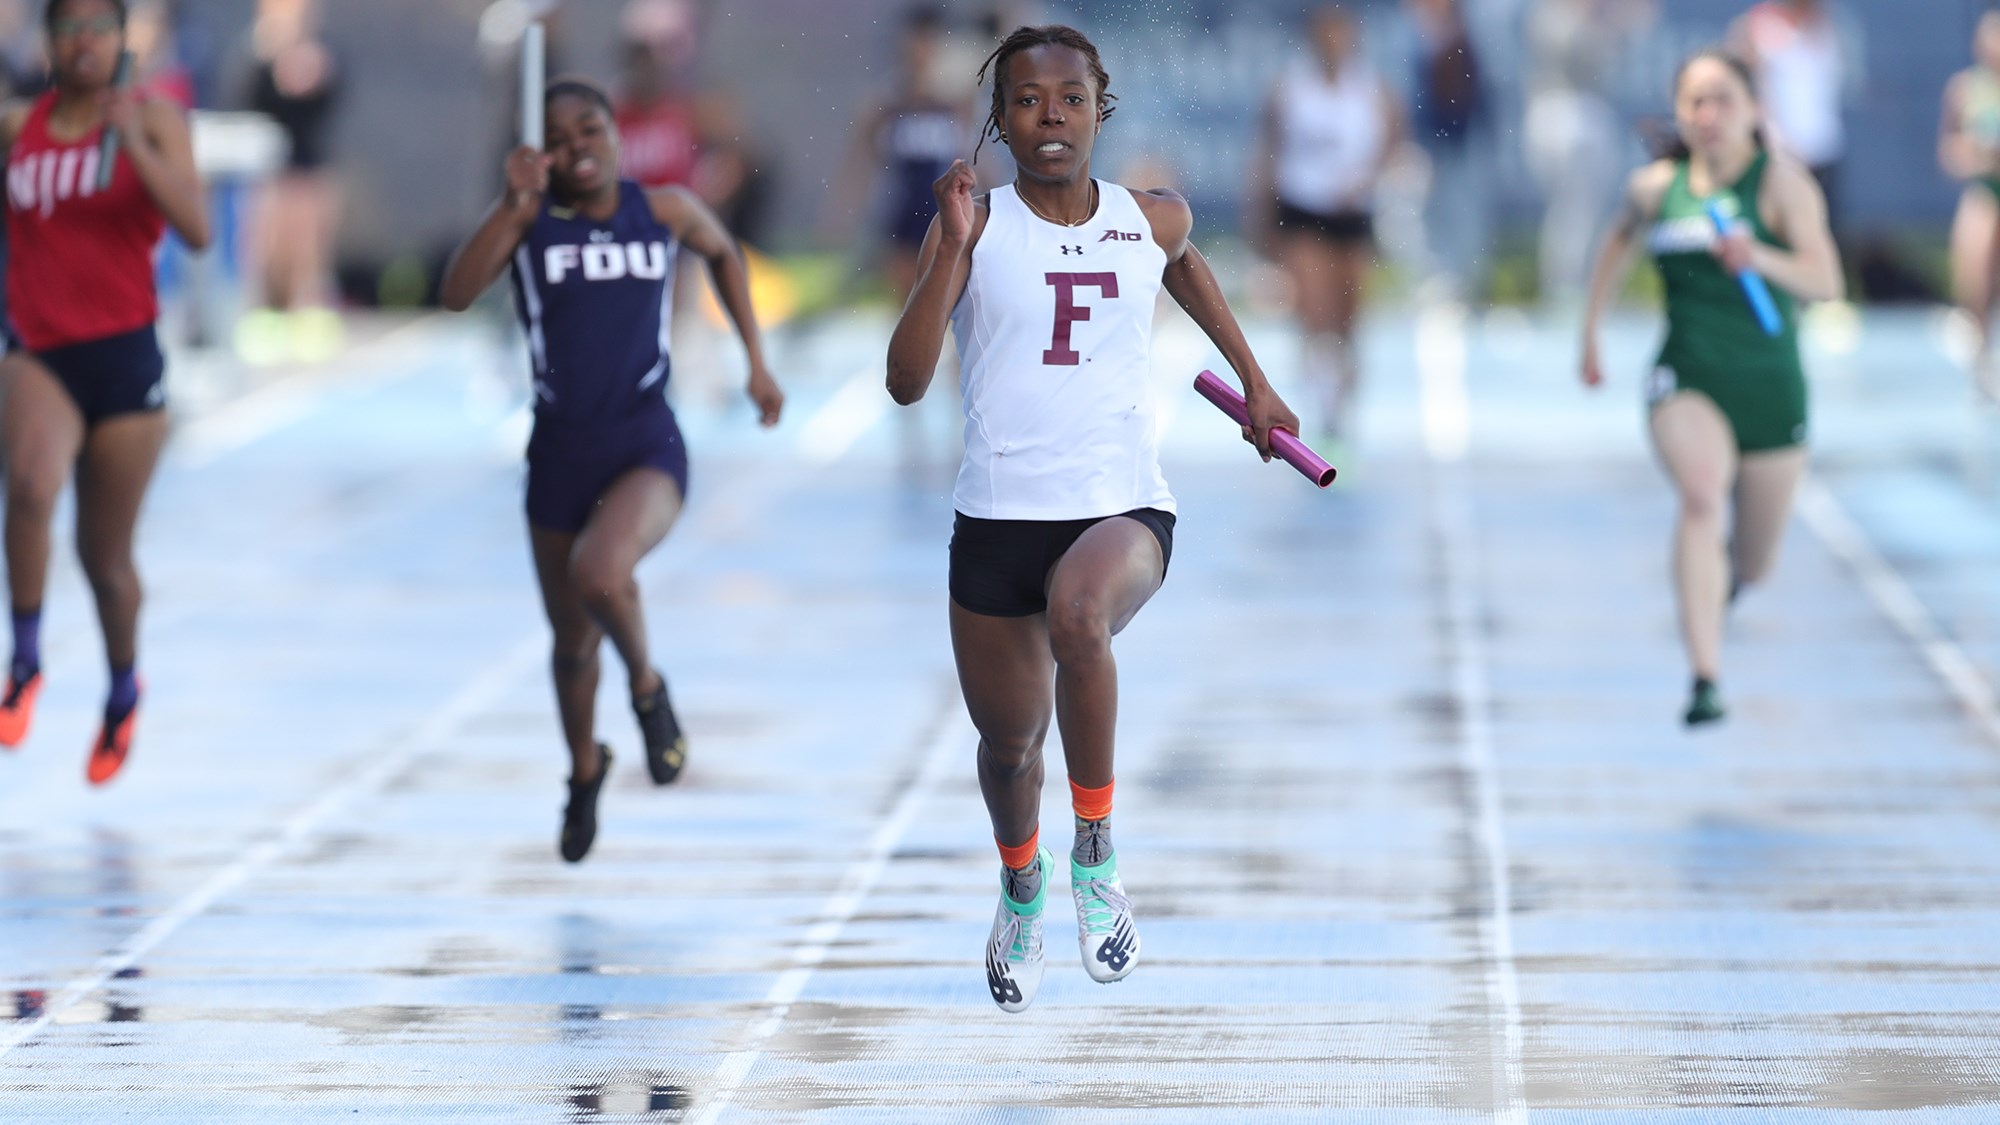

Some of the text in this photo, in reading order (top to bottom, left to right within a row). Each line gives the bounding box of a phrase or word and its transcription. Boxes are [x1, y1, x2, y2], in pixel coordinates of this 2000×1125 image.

[1097, 229, 1142, 242] A10
[544, 240, 667, 284] FDU
[1042, 271, 1119, 366] F
